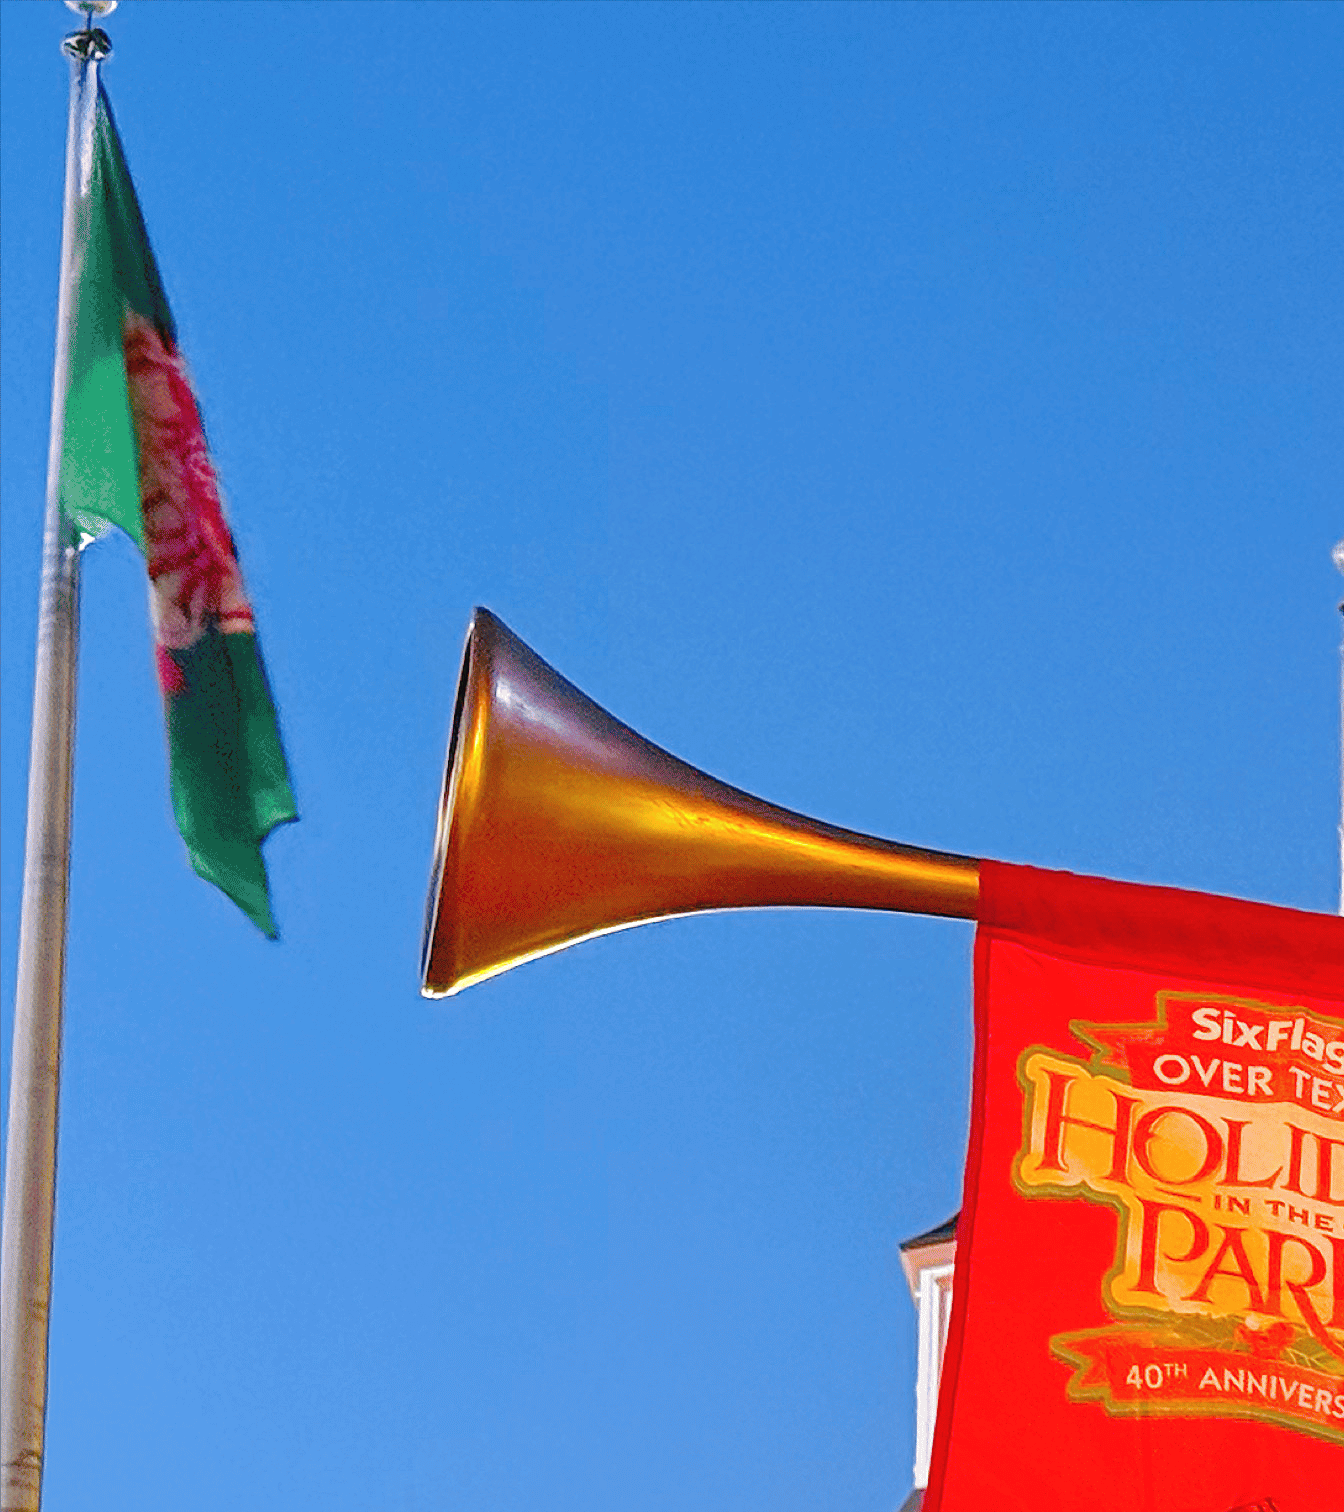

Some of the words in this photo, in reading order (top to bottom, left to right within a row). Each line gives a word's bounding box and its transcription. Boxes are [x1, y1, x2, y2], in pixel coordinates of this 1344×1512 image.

[1152, 1053, 1274, 1097] OVER
[1213, 1194, 1251, 1217] IN
[1264, 1199, 1336, 1234] THE
[1125, 1362, 1188, 1390] 40TH
